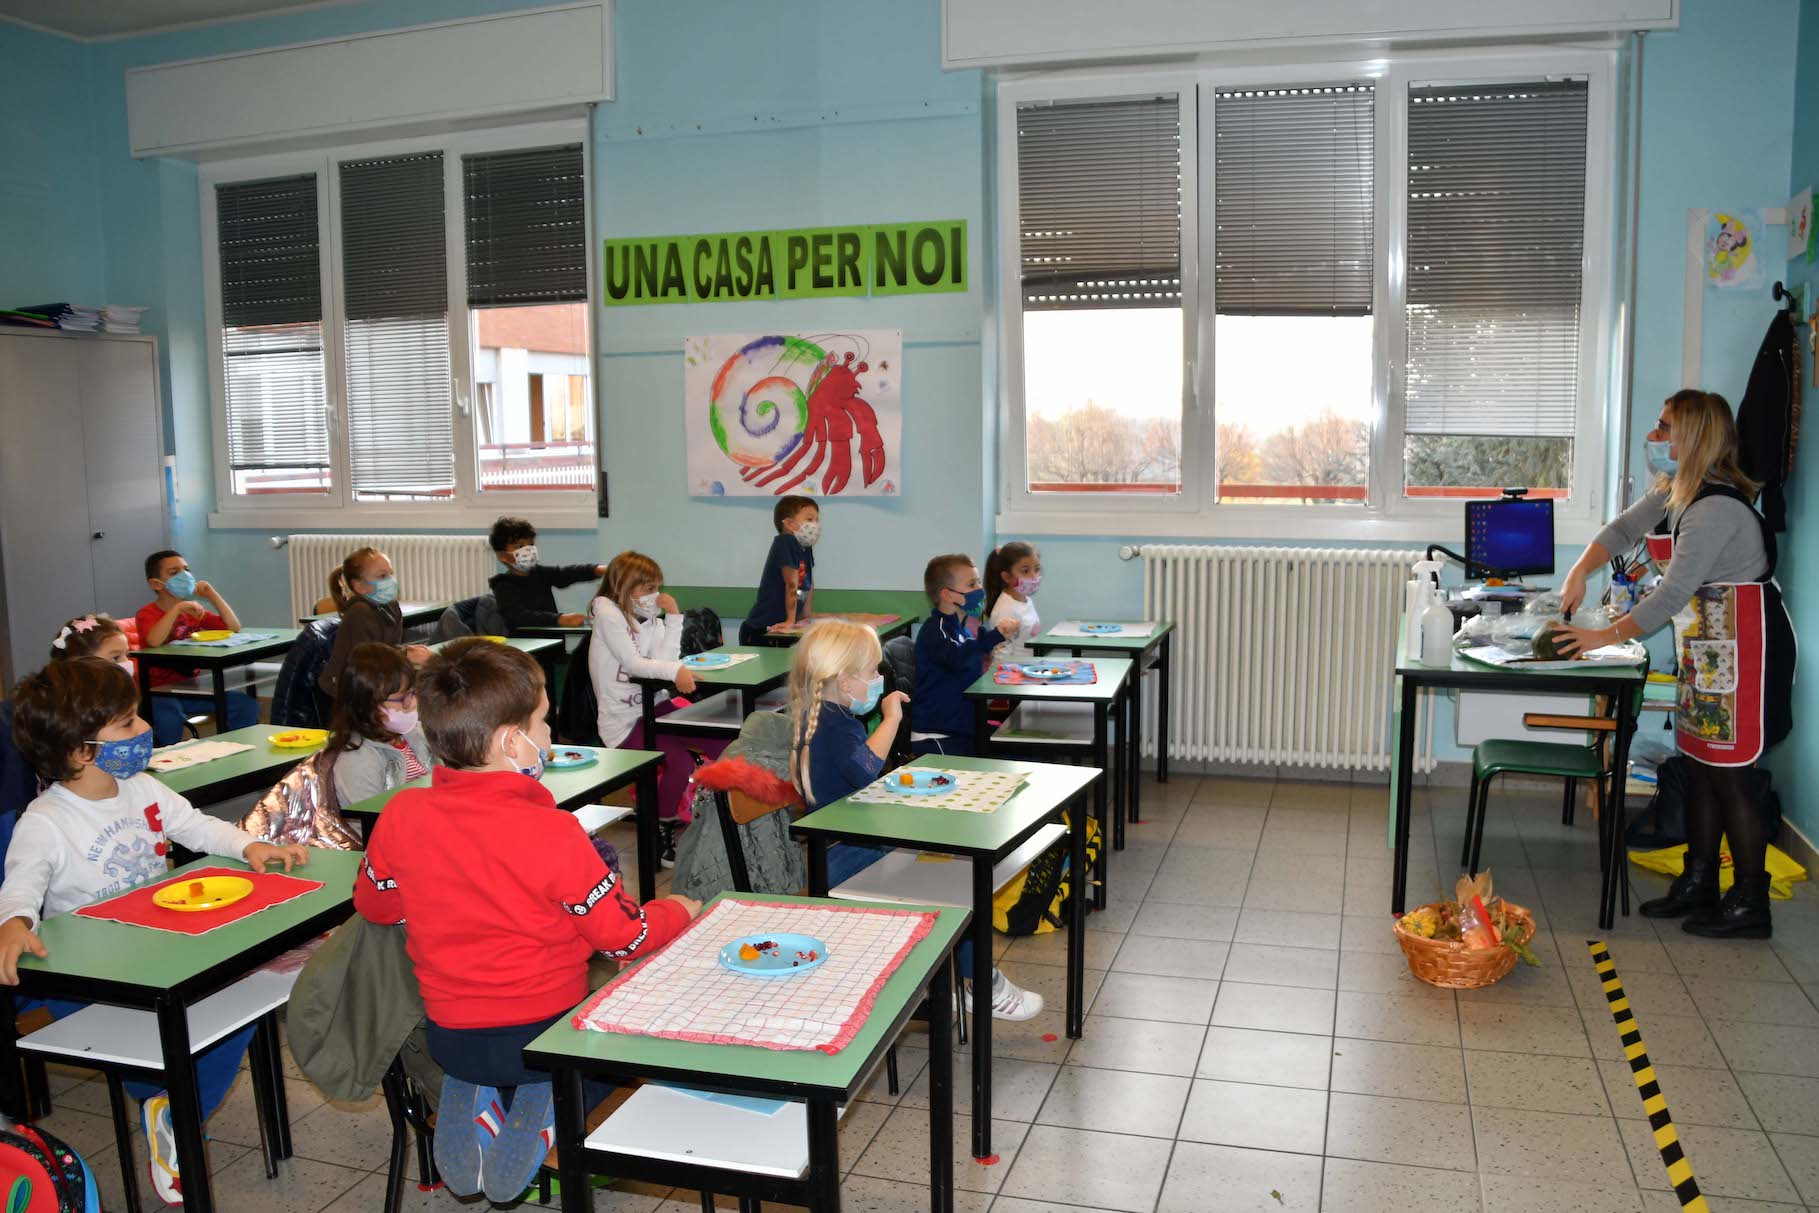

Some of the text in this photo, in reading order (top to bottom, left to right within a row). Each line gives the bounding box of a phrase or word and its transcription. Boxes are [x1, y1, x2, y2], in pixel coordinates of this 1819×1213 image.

[606, 227, 962, 299] UNA CASA PER NOI
[586, 878, 613, 908] BREAK
